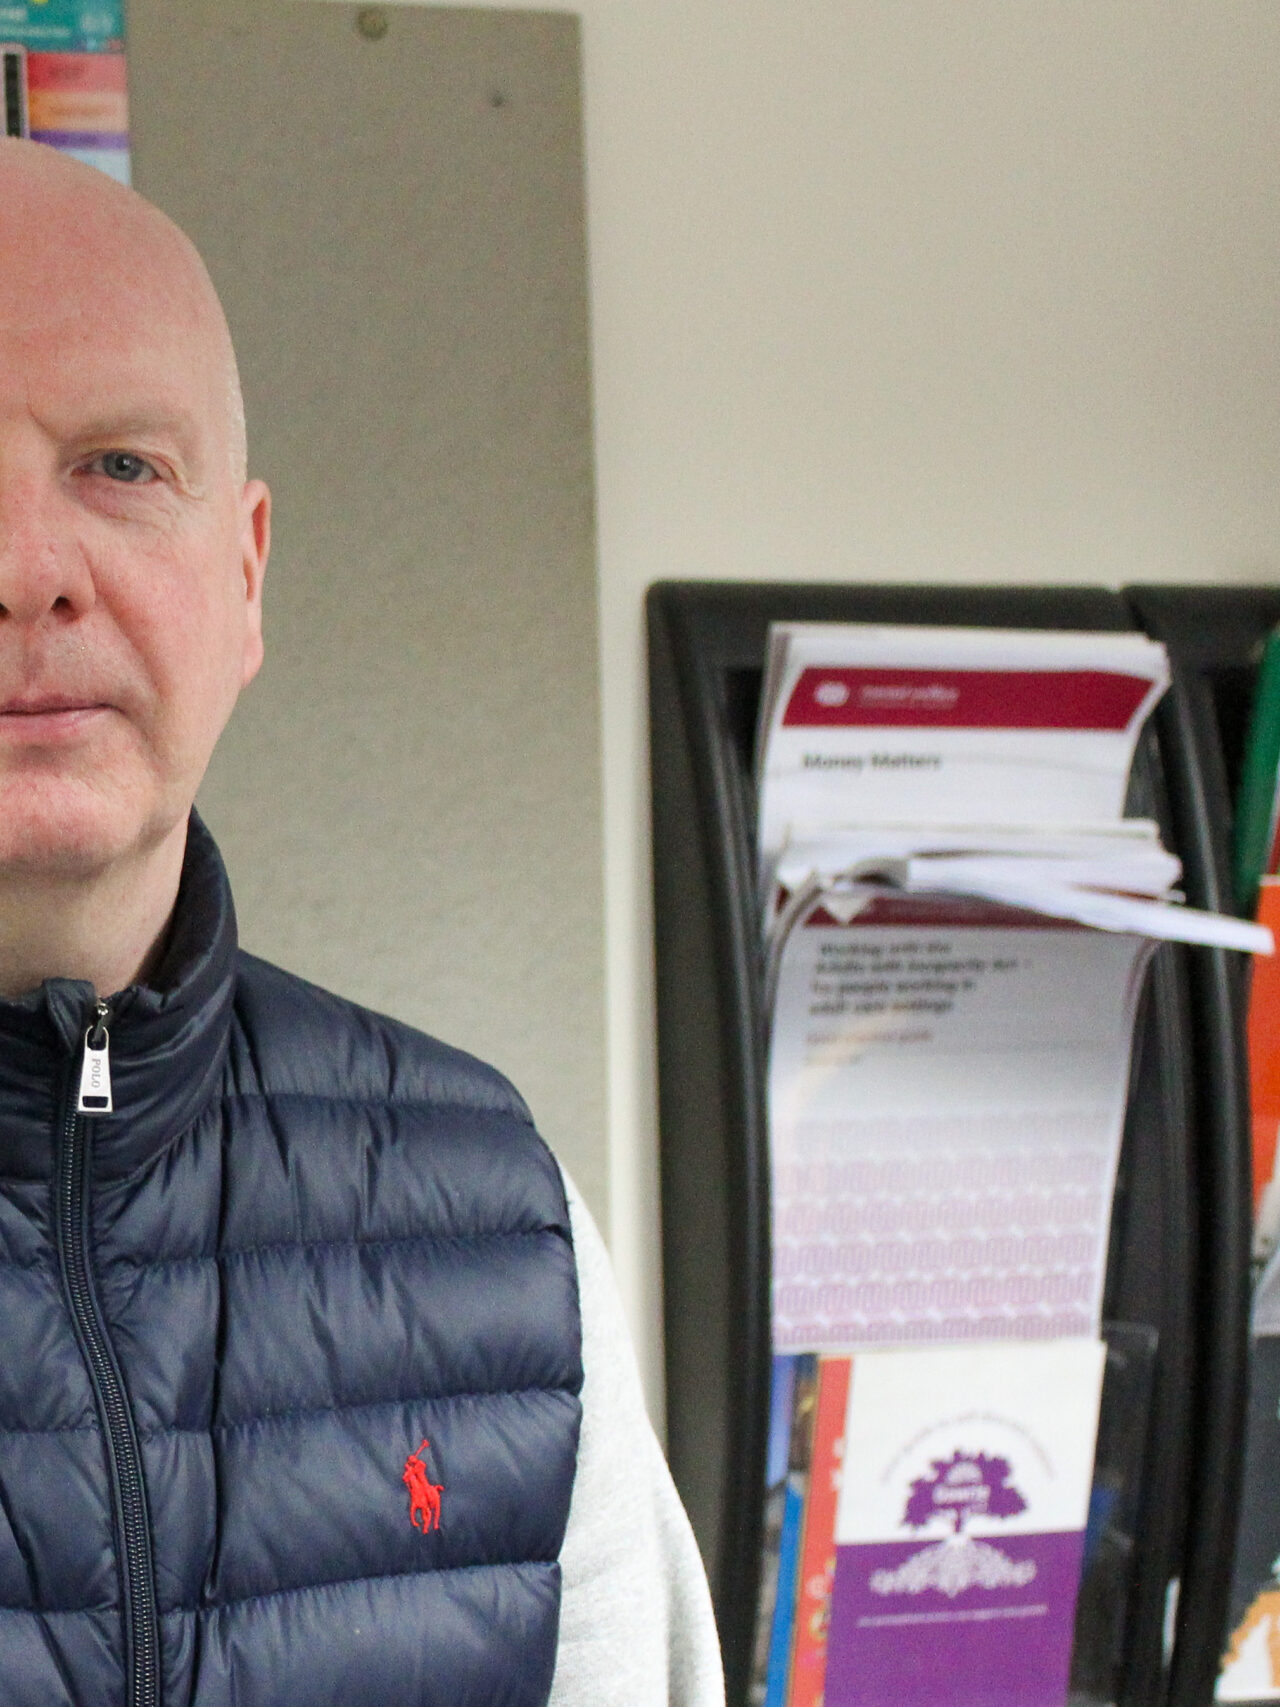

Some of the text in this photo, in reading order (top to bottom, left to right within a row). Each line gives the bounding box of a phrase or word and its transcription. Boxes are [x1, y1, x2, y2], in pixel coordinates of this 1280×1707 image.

[803, 753, 940, 773] Money Matters
[821, 940, 952, 957] Working with the
[815, 960, 863, 974] Adults
[871, 959, 901, 973] with
[839, 981, 889, 998] people
[895, 978, 958, 996] working
[91, 1058, 102, 1089] POLO
